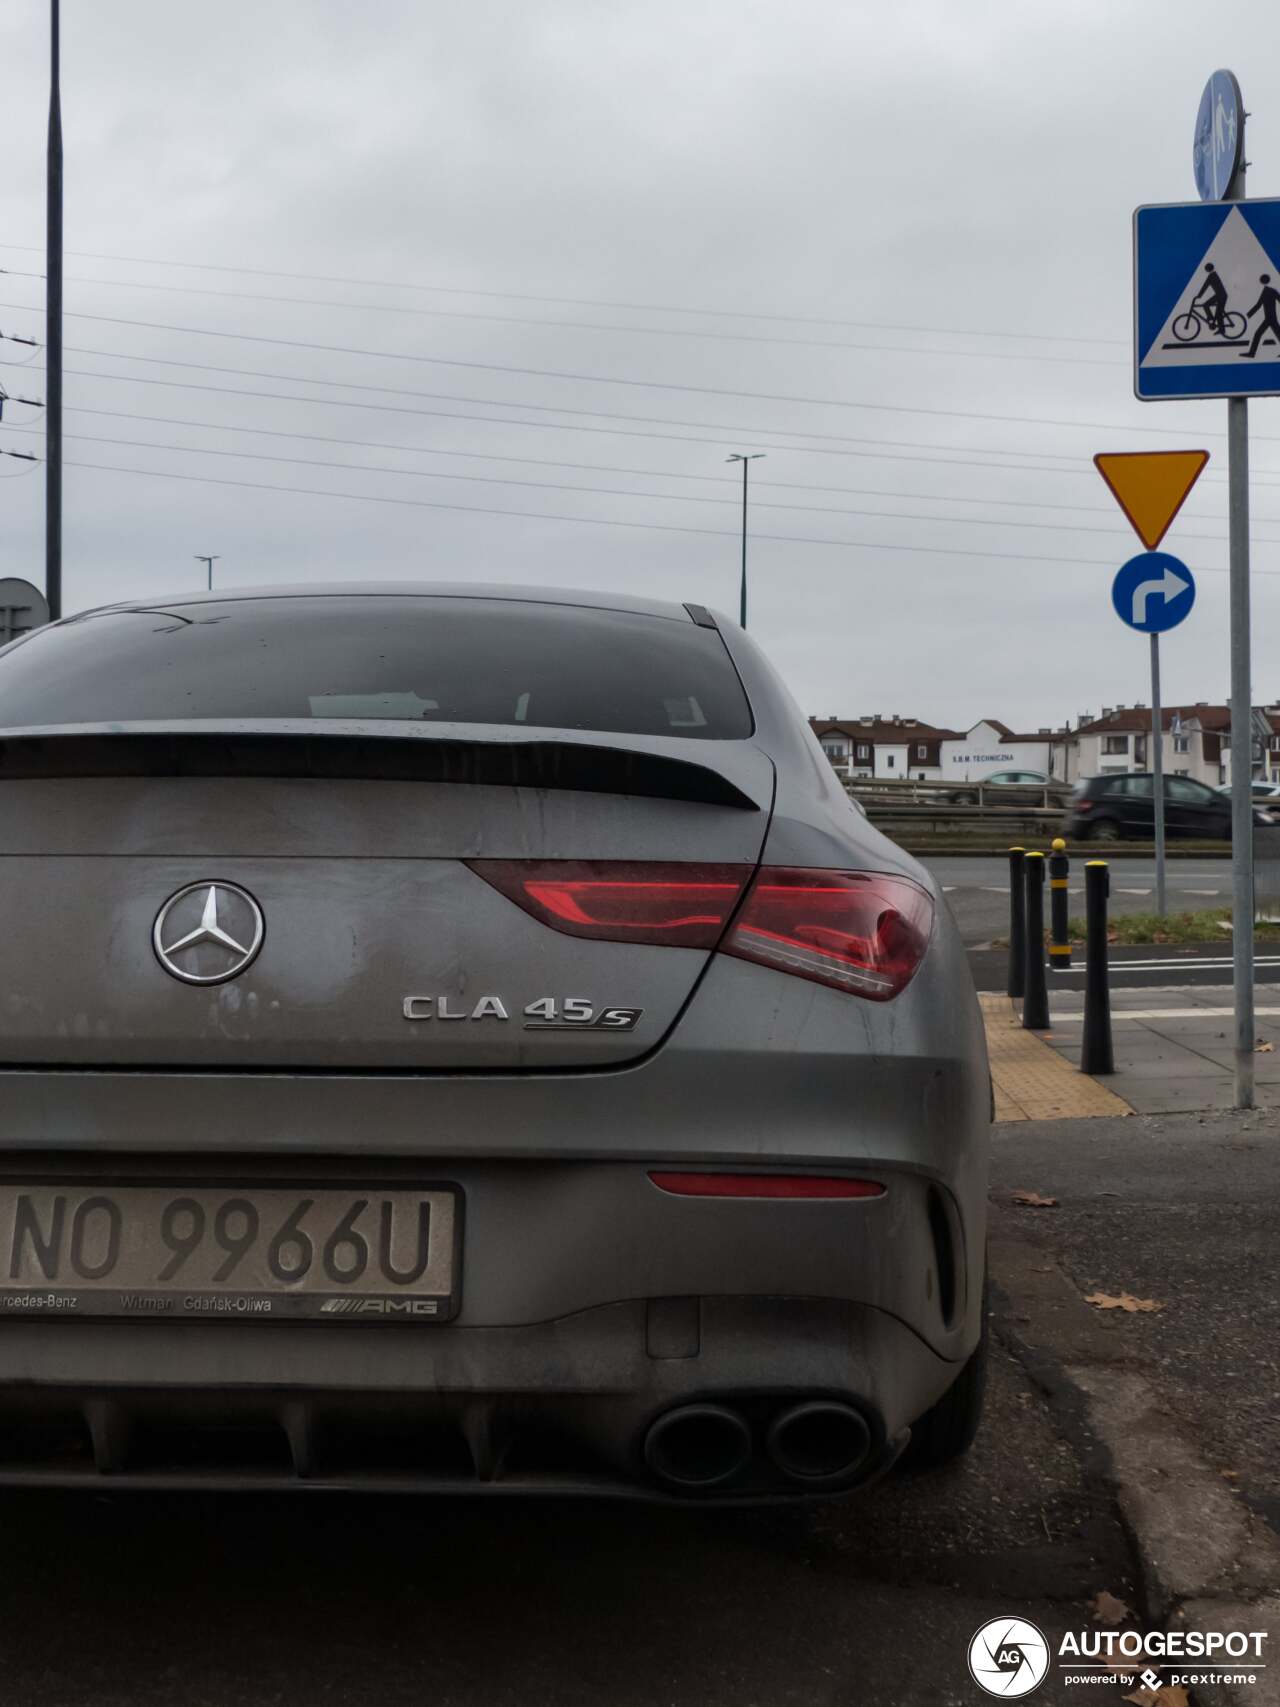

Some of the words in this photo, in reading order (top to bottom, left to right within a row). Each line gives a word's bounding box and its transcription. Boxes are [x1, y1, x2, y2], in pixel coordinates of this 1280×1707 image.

[402, 996, 509, 1020] CLA
[9, 1195, 123, 1280] NO
[157, 1197, 431, 1286] 9966U
[0, 1294, 77, 1308] rcedes-Benz
[358, 1300, 438, 1315] AMG
